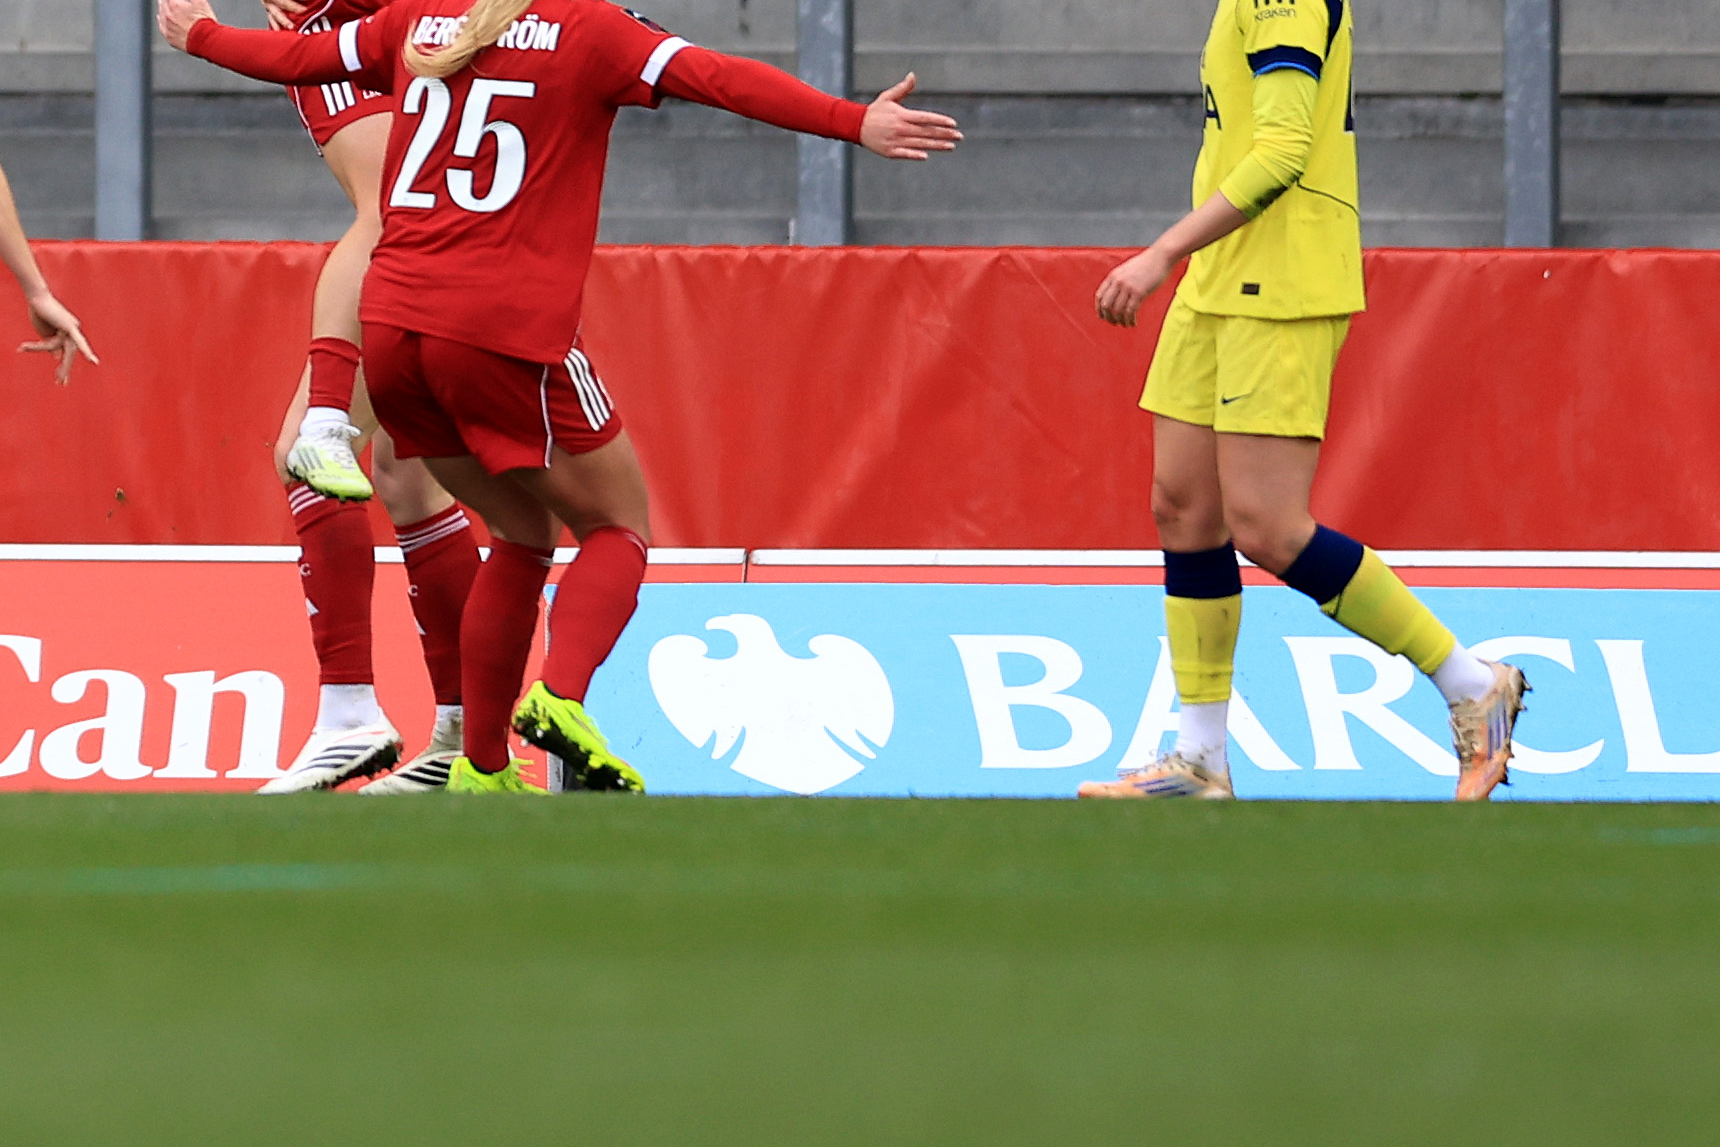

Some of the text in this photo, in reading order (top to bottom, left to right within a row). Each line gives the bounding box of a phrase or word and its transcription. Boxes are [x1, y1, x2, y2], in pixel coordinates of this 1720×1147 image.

[411, 13, 561, 52] BERRÖM
[1253, 6, 1297, 23] kraken
[389, 76, 536, 213] 25
